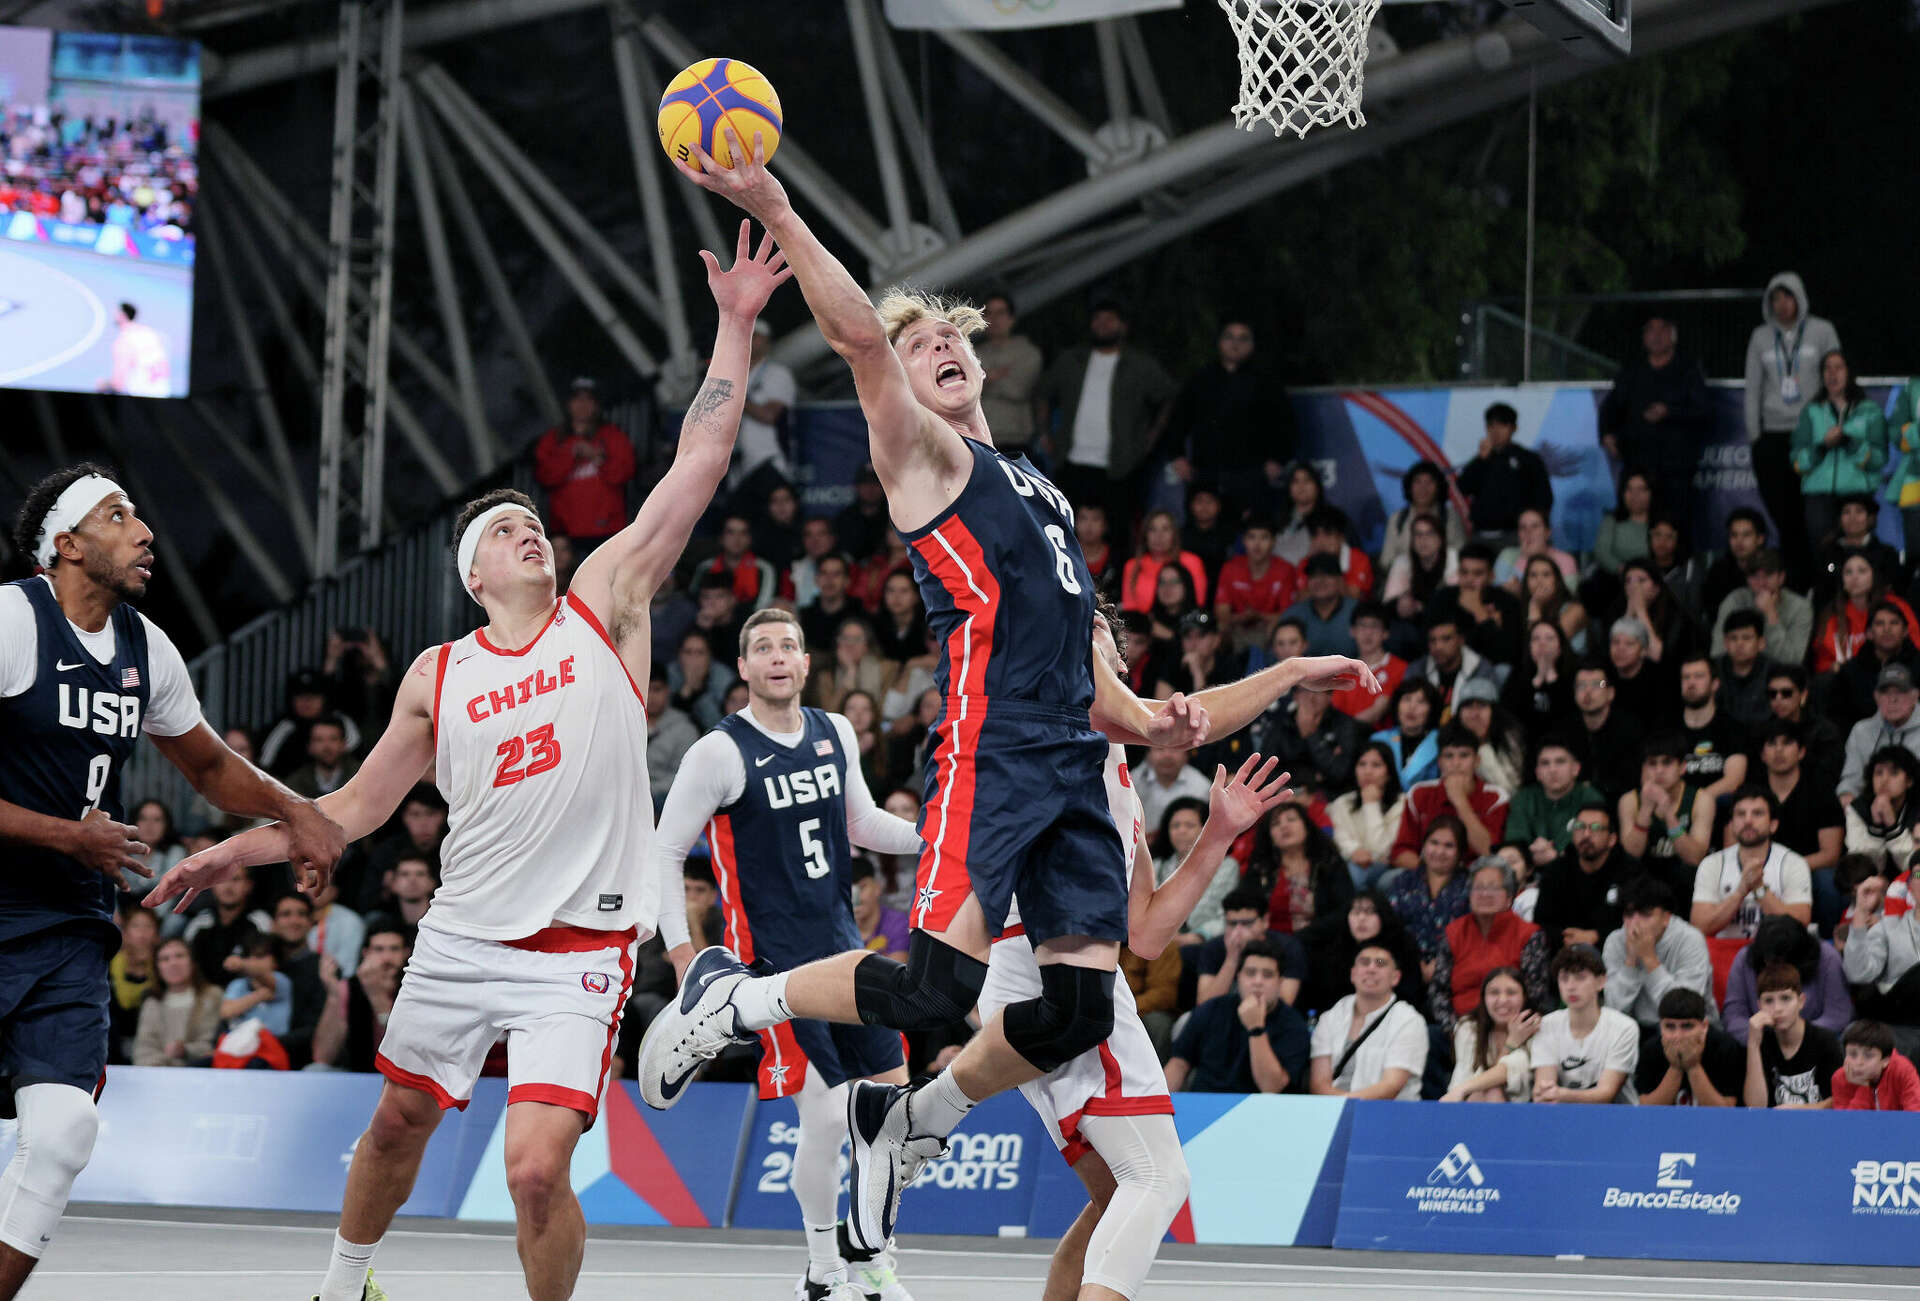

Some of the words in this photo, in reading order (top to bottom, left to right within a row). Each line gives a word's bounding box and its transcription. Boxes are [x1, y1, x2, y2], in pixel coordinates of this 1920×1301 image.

[997, 459, 1074, 528] USA
[1044, 524, 1081, 595] 6
[58, 683, 140, 738] USA
[467, 655, 576, 723] CHILE
[493, 722, 562, 788] 23
[80, 754, 112, 821] 9
[764, 764, 841, 809] USA
[799, 818, 831, 879] 5
[948, 1133, 1023, 1161] NAM
[914, 1160, 1019, 1190] PORTS
[1406, 1186, 1500, 1202] ANTOFAGASTA
[1603, 1187, 1742, 1210] BancoEstado
[1418, 1199, 1485, 1214] MINERALS
